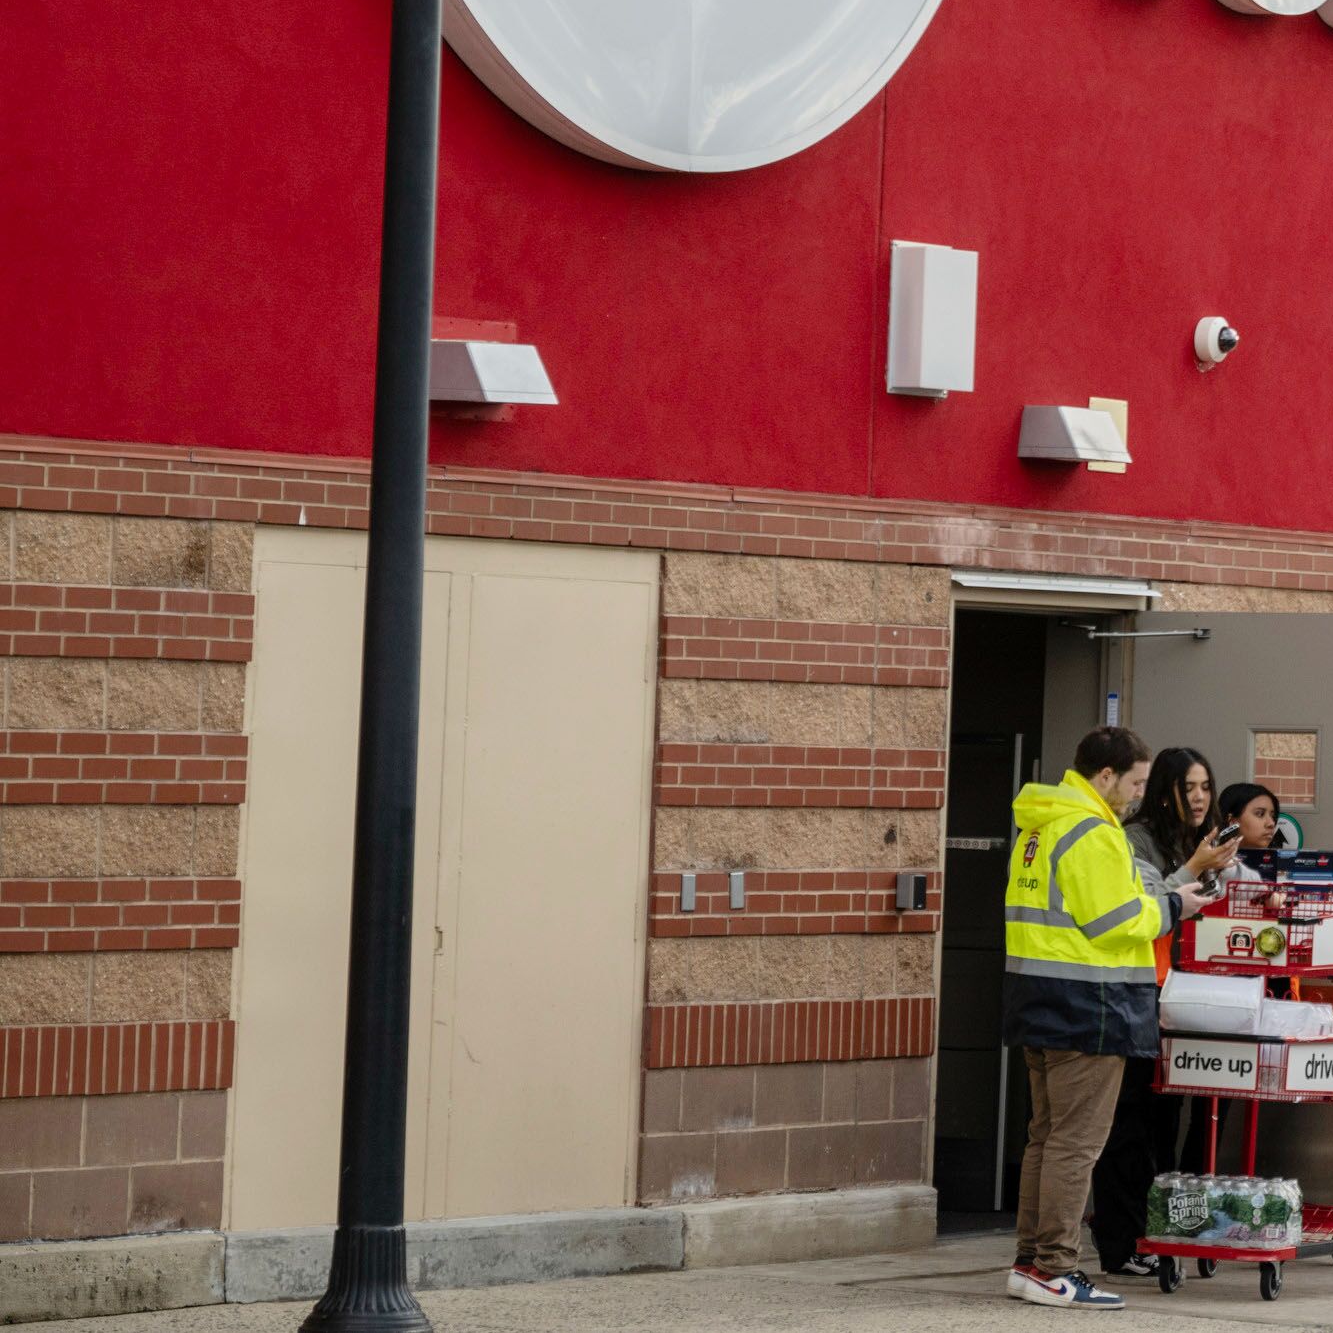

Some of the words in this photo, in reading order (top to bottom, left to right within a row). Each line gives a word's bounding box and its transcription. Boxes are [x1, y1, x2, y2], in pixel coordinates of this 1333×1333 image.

[1174, 1051, 1223, 1072] drive
[1228, 1058, 1253, 1078] up
[1168, 1193, 1207, 1210] Poland
[1169, 1207, 1208, 1223] Spring
